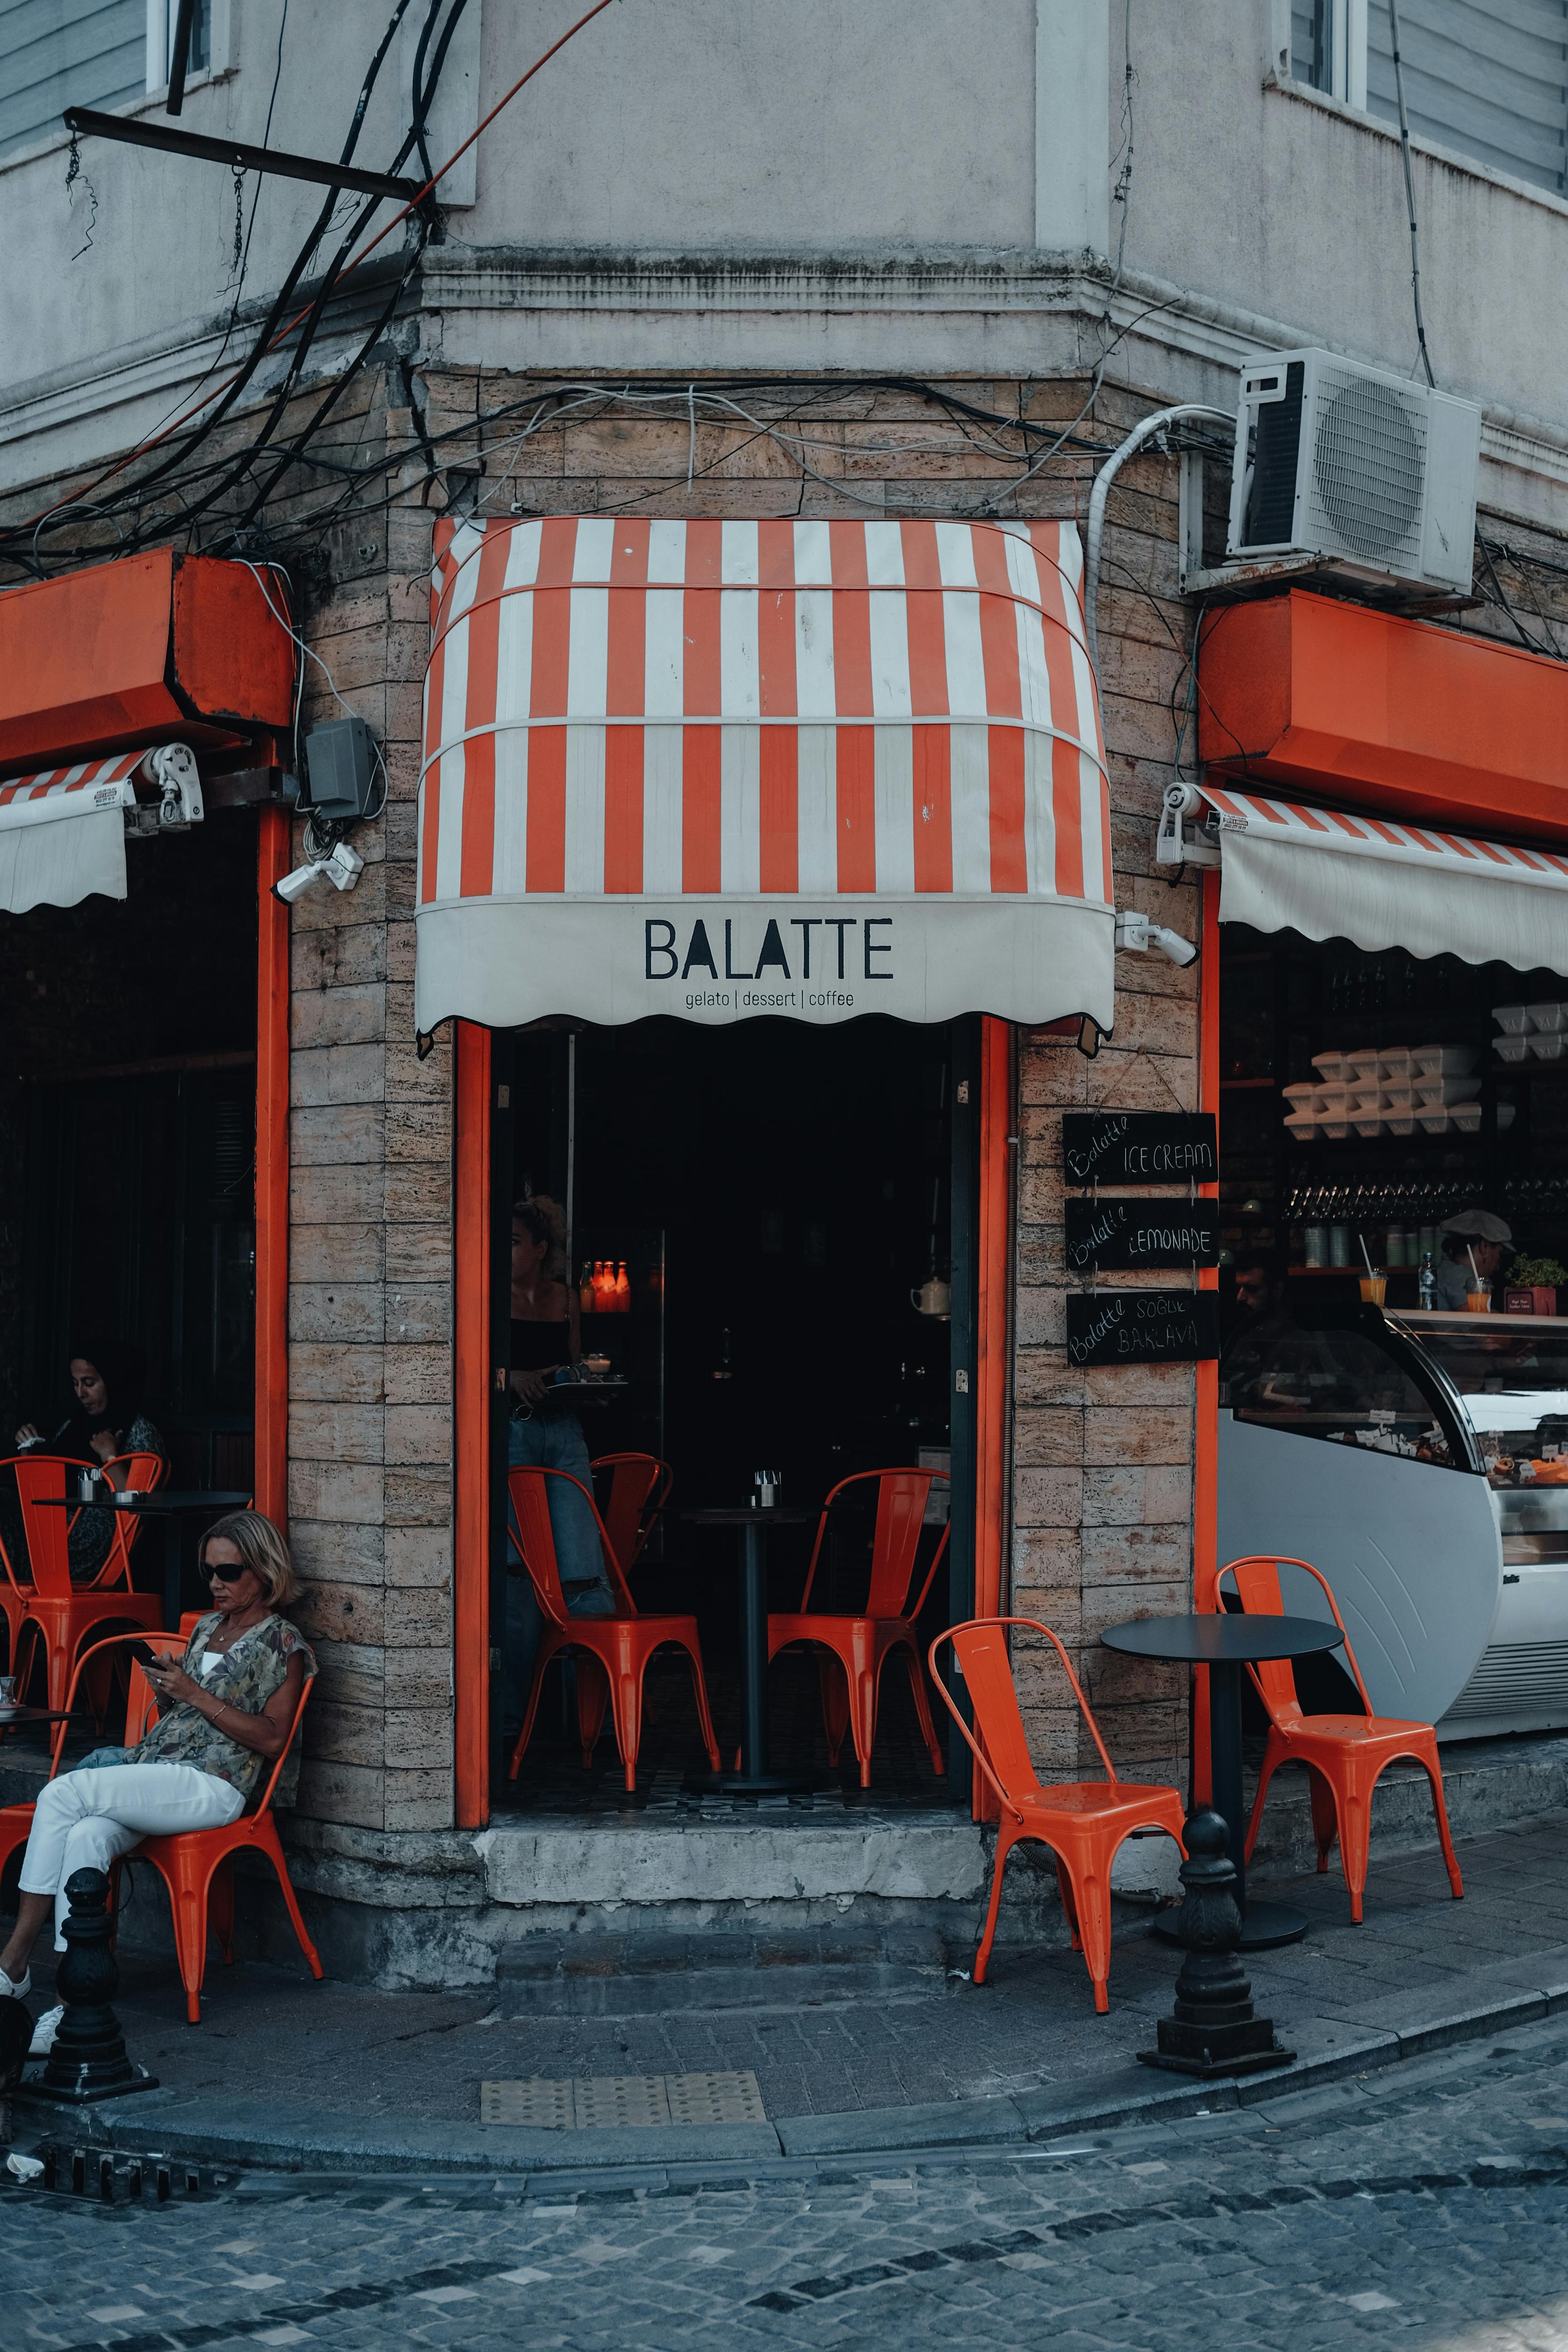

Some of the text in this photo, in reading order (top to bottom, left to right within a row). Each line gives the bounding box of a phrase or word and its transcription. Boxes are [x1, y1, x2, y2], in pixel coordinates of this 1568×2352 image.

[645, 918, 893, 979] BALATTE
[686, 991, 854, 1009] gelato dessert coffee
[1068, 1116, 1129, 1177] Balatte
[1124, 1143, 1212, 1173] ICE CREAM
[1129, 1227, 1211, 1252] LEMONADE
[1070, 1299, 1125, 1362] Balatte
[1117, 1320, 1198, 1353] BAKLAVA
